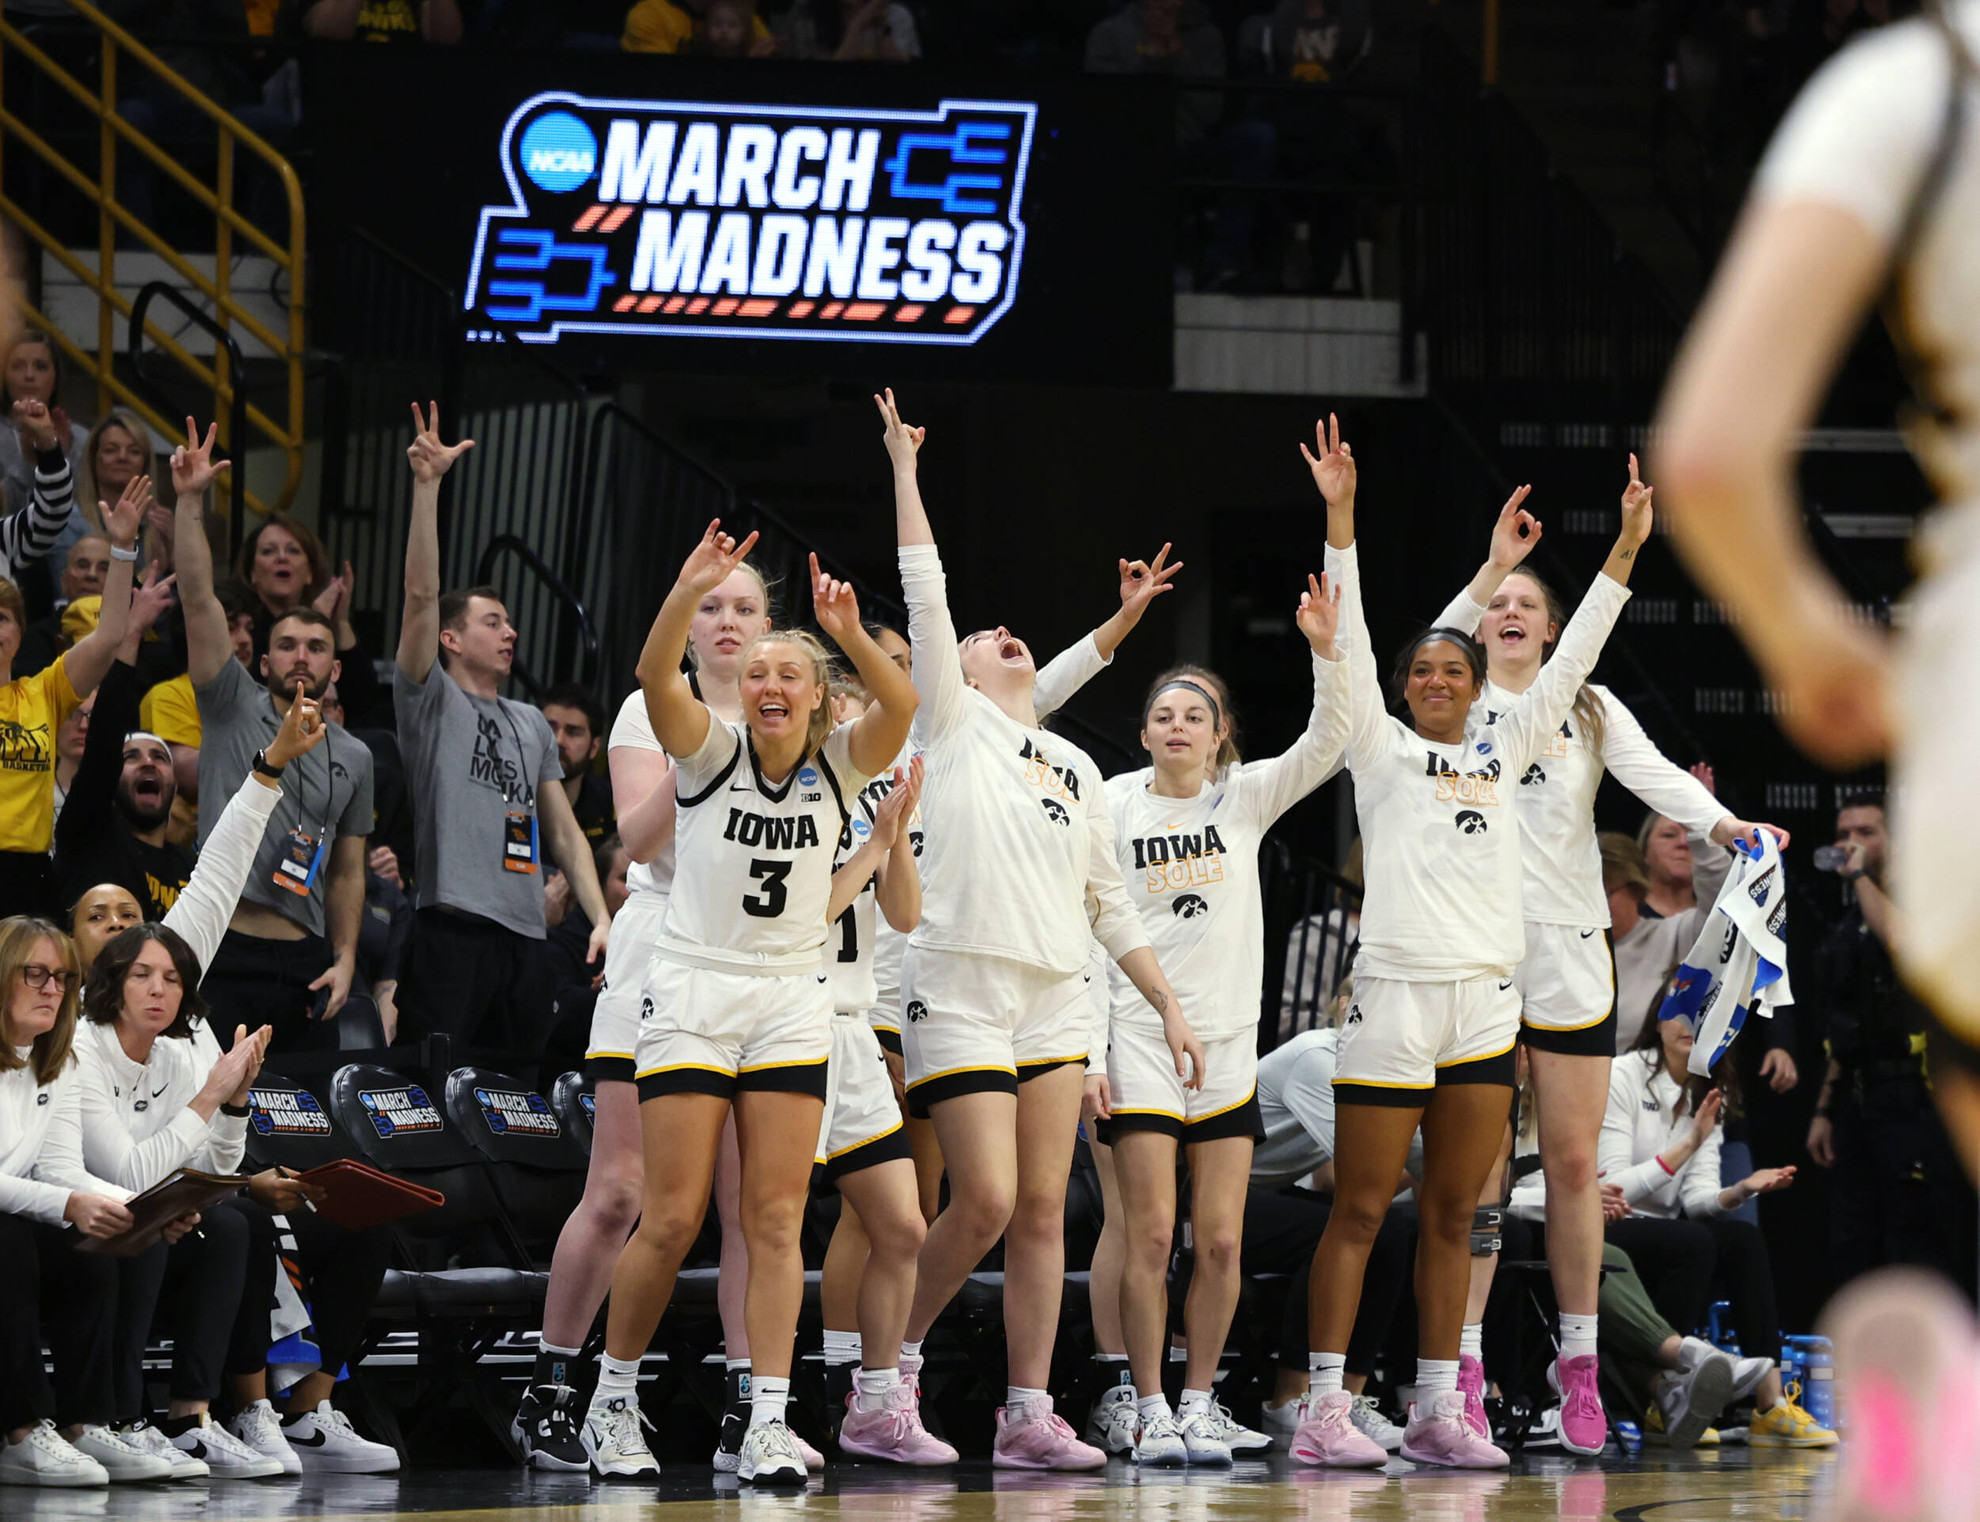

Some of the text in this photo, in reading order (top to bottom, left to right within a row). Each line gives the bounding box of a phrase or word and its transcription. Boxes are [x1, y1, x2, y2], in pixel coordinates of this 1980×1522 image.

[530, 150, 594, 173] NCAA
[599, 119, 880, 211] MARCH
[630, 209, 1009, 303] MADNESS
[723, 807, 819, 850] IOWA
[1132, 825, 1226, 869] IOWA
[1146, 850, 1223, 893] SOLE
[742, 858, 793, 918] 3
[254, 1092, 299, 1111] MARCH
[372, 1091, 411, 1111] MARCH
[488, 1093, 530, 1112] MARCH
[269, 1110, 328, 1128] MADNESS
[386, 1107, 440, 1126] MADNESS
[502, 1110, 557, 1130] MADNESS
